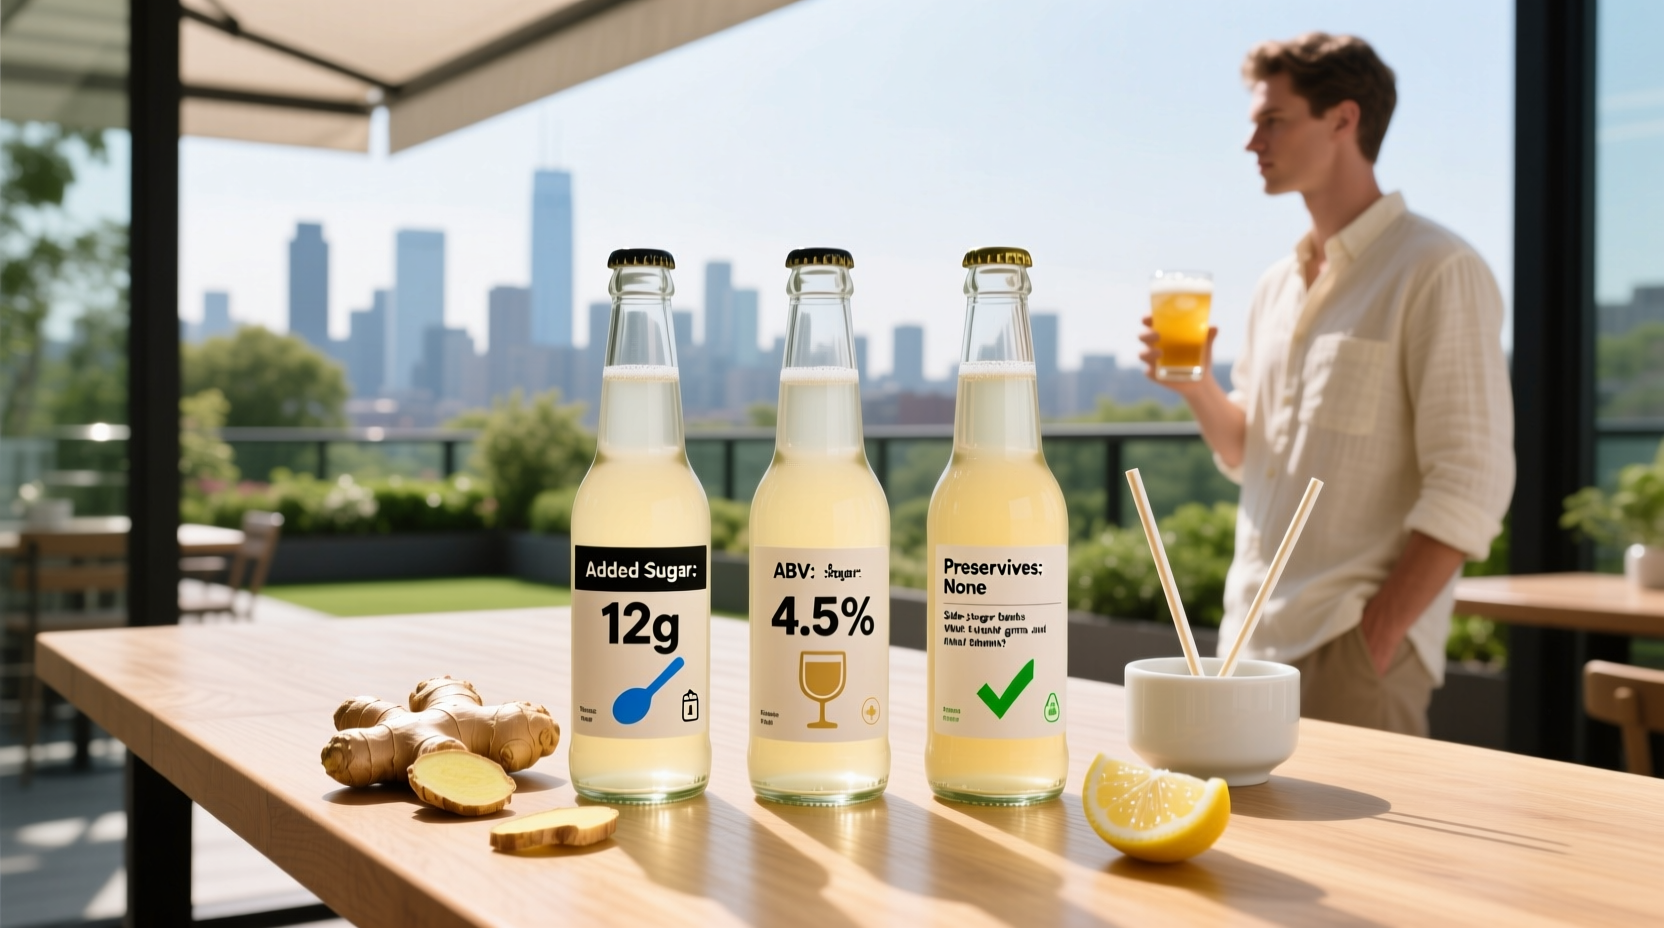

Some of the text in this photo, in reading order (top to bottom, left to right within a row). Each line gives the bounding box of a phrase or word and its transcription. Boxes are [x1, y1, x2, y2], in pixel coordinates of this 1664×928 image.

[586, 561, 697, 583] Added Sugar:
[773, 562, 815, 579] ABV:
[944, 578, 987, 595] None
[771, 596, 875, 636] 4.5%
[601, 601, 679, 655] 12g
